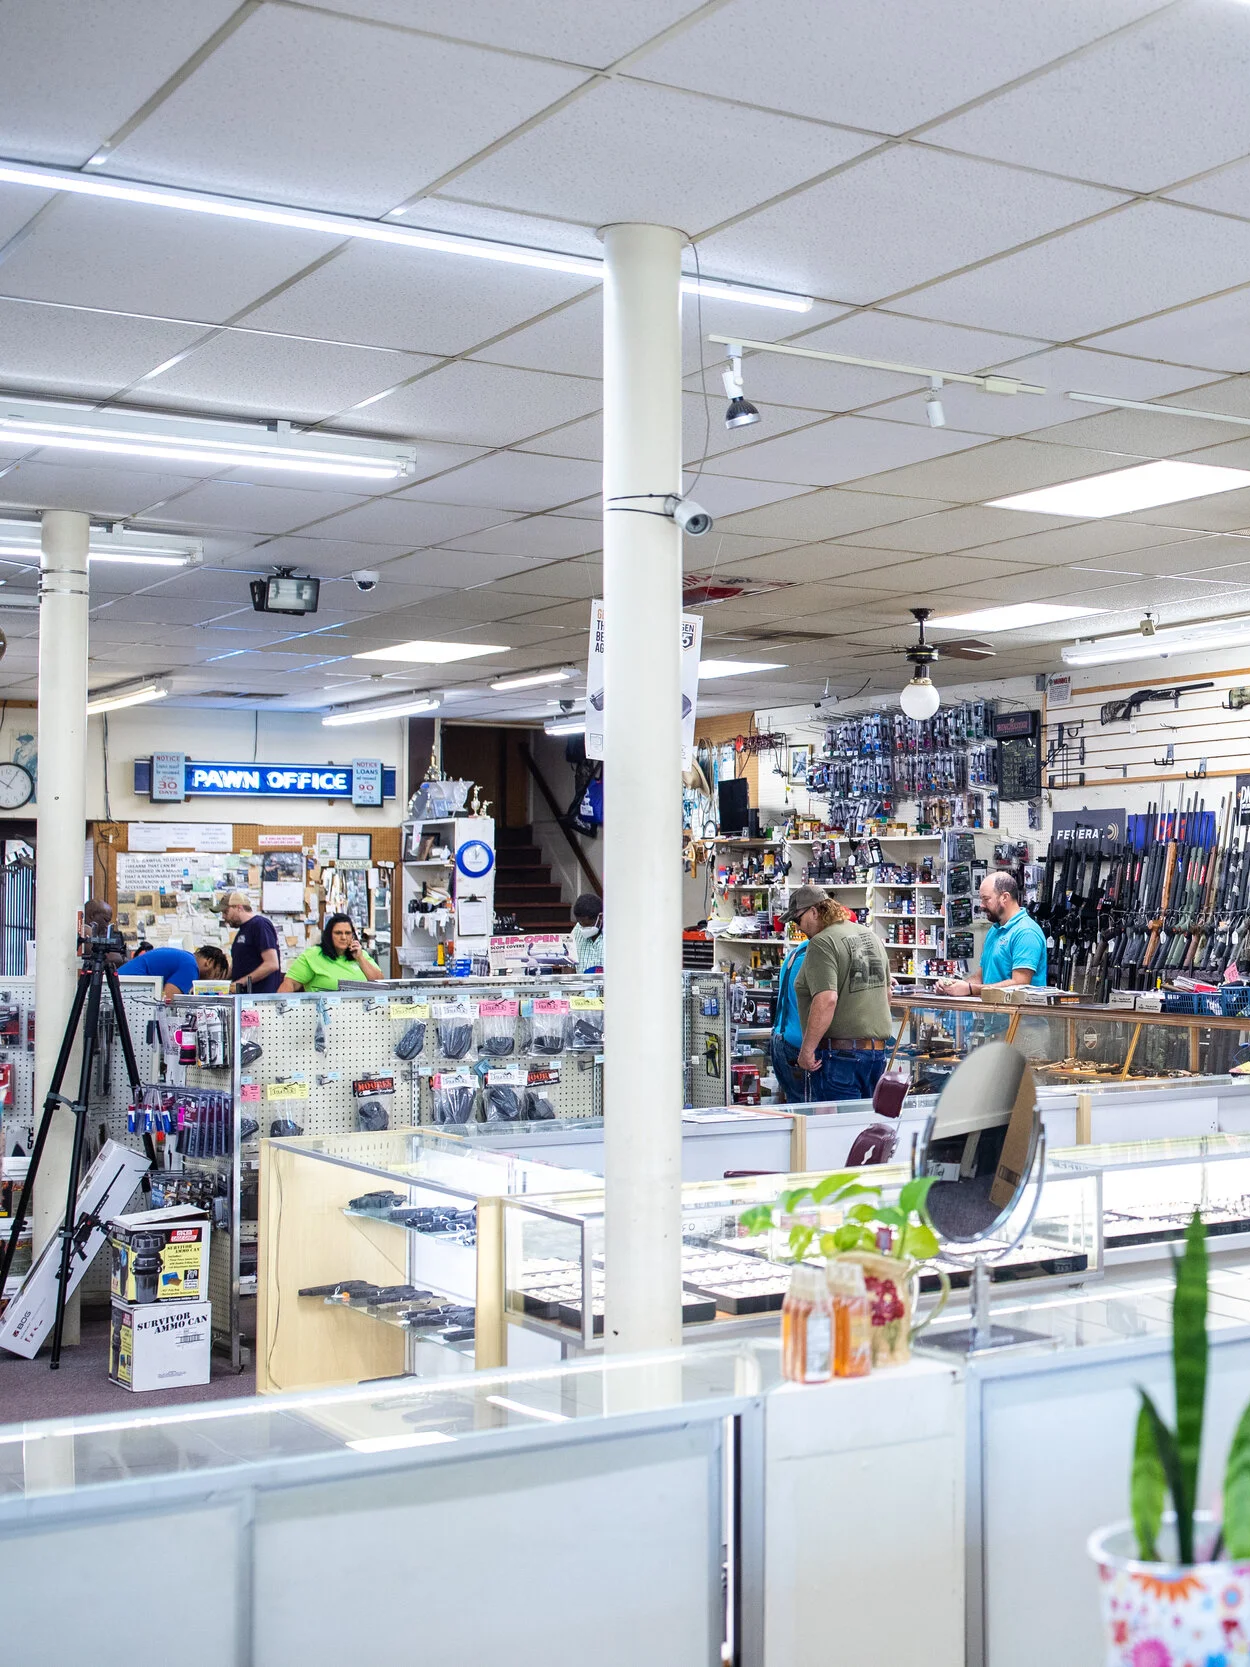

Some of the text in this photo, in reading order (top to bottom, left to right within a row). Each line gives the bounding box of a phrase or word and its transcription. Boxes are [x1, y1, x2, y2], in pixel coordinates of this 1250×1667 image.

[158, 781, 178, 789] 30
[193, 769, 347, 790] PAWN OFFICE
[490, 934, 560, 946] FLIP-OPEN
[137, 1312, 191, 1331] SURVIVOR
[154, 1314, 208, 1334] AMMO CAN
